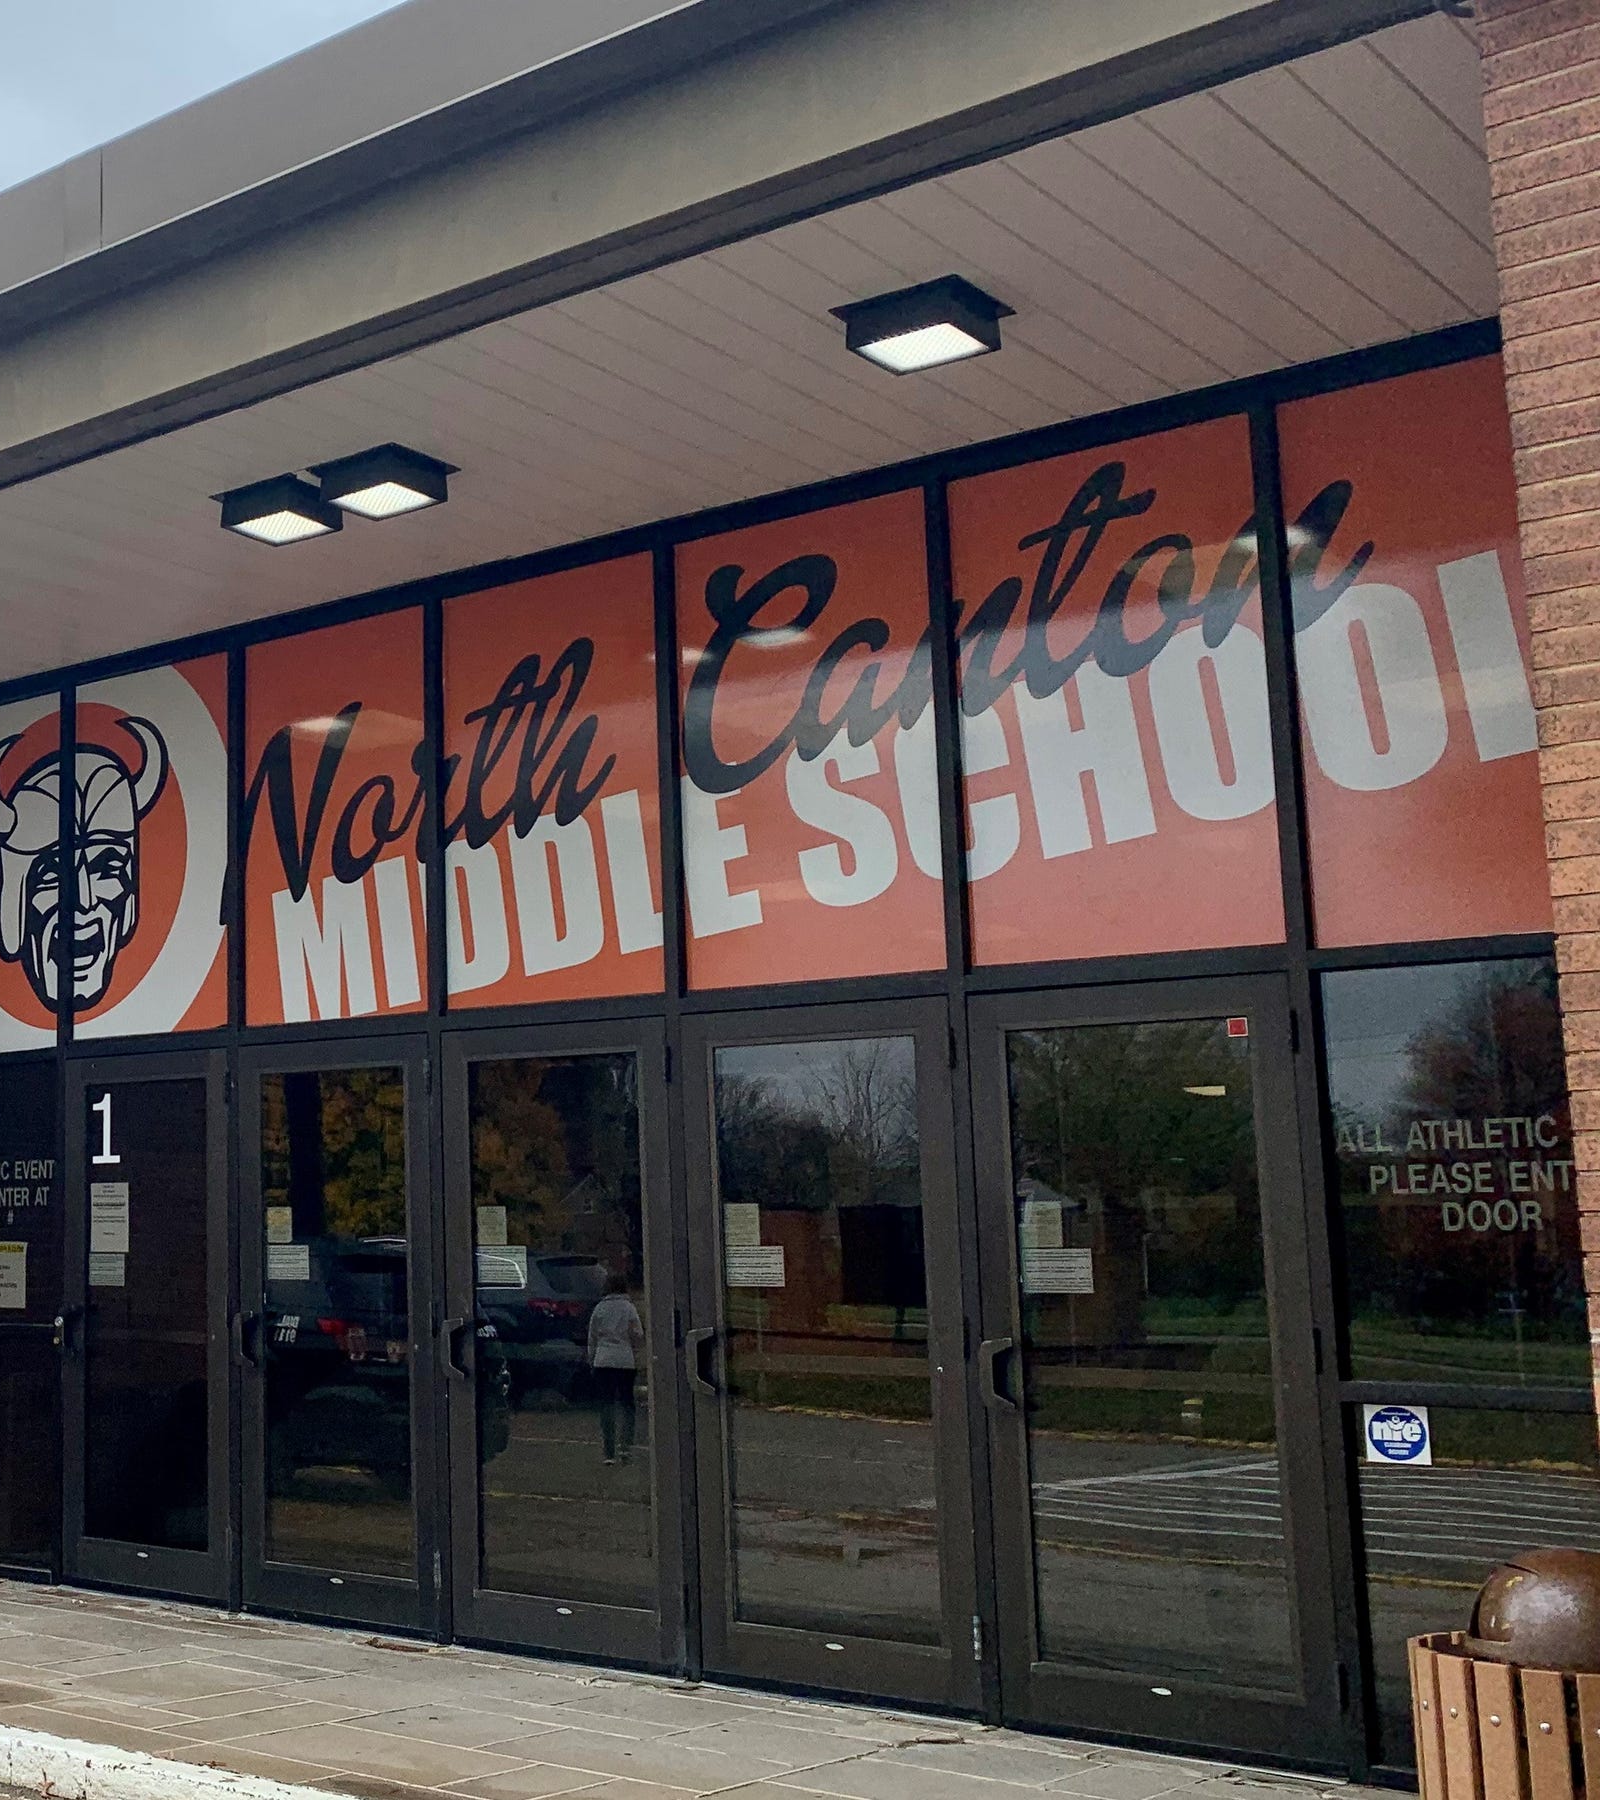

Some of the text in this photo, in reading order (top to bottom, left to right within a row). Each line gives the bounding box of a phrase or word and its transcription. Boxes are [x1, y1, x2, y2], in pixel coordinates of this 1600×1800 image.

[219, 462, 1375, 925] North Canton
[271, 760, 763, 1024] MIDDLE
[92, 1093, 120, 1164] 1
[1336, 1115, 1559, 1153] ALL ATHLETIC
[15, 1159, 55, 1180] EVENT
[1369, 1161, 1495, 1195] PLEASE
[34, 1185, 50, 1206] AT
[7, 1209, 14, 1225] #
[1442, 1199, 1543, 1232] DOOR
